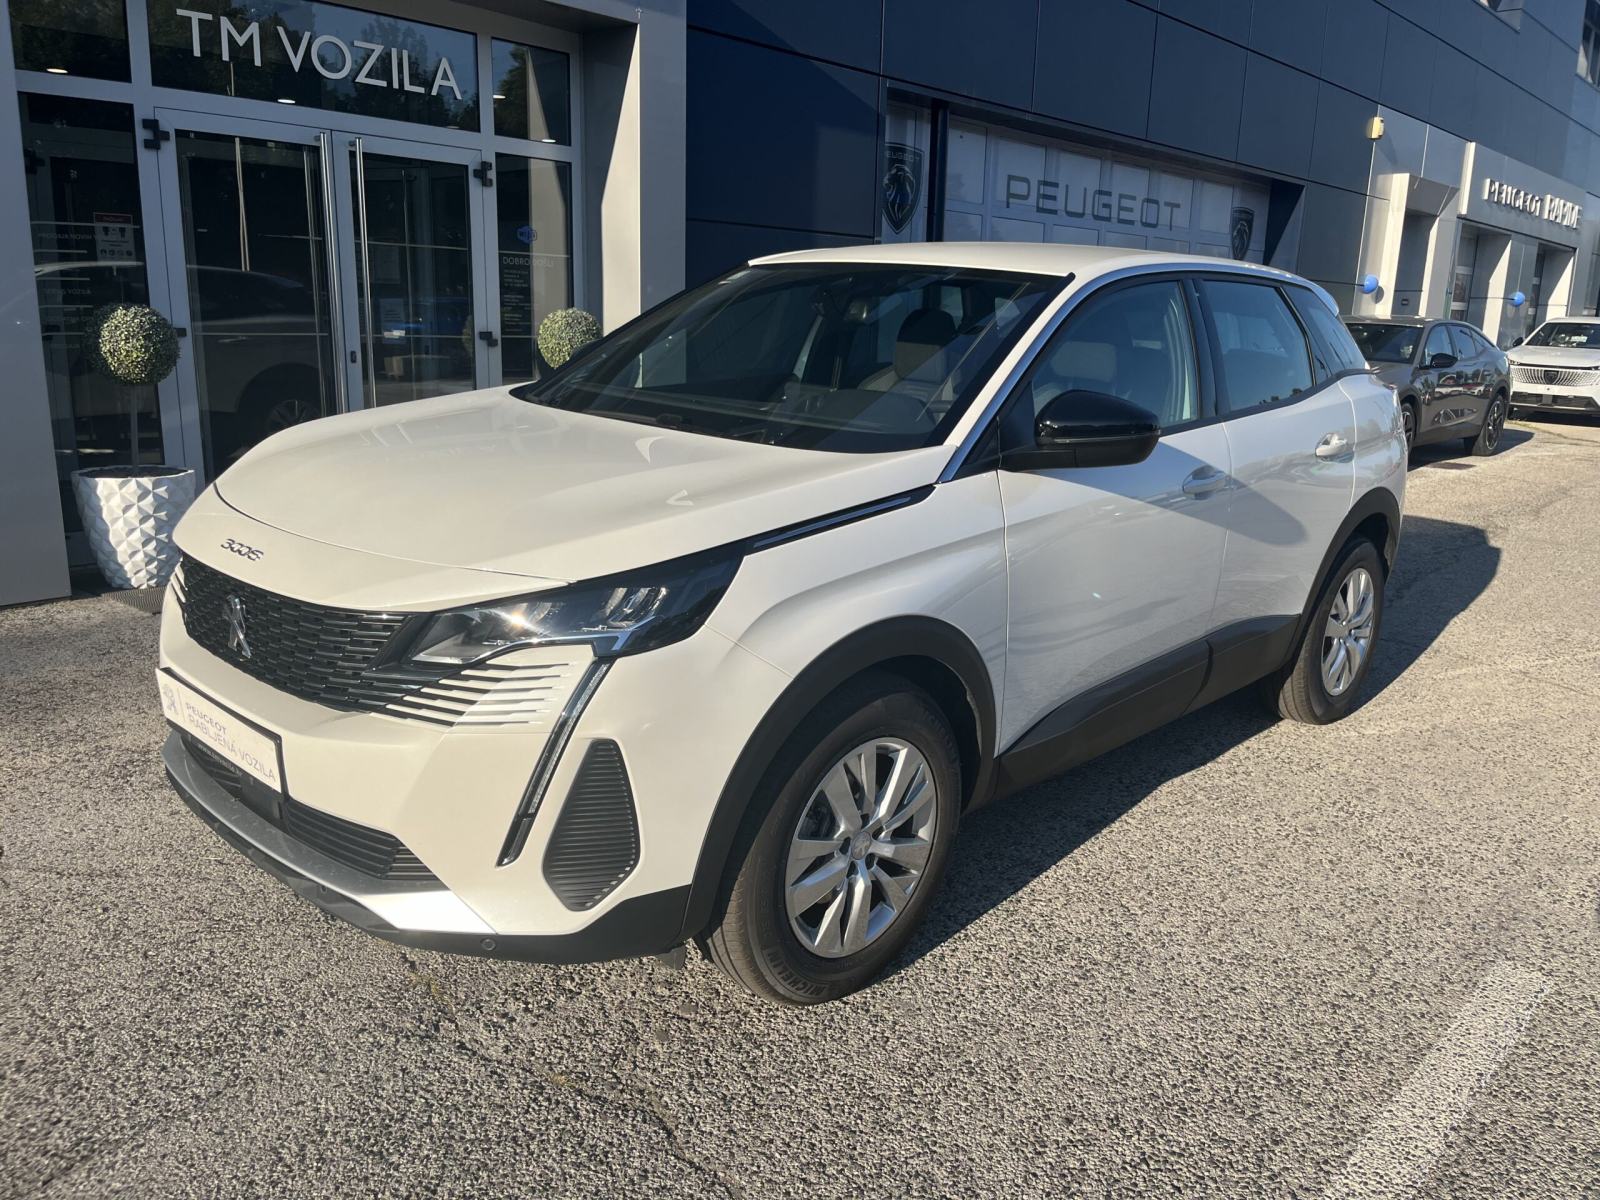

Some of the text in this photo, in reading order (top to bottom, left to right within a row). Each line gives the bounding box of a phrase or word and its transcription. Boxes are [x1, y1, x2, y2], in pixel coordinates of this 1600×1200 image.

[176, 9, 463, 100] TM VOZILA
[1006, 174, 1181, 231] PEUGEOT
[503, 256, 530, 266] DOBRO
[185, 702, 227, 735] PEUGEOT
[188, 714, 238, 757] RABLJENA
[238, 748, 277, 783] VOZILA
[767, 949, 829, 997] MICHELIN
